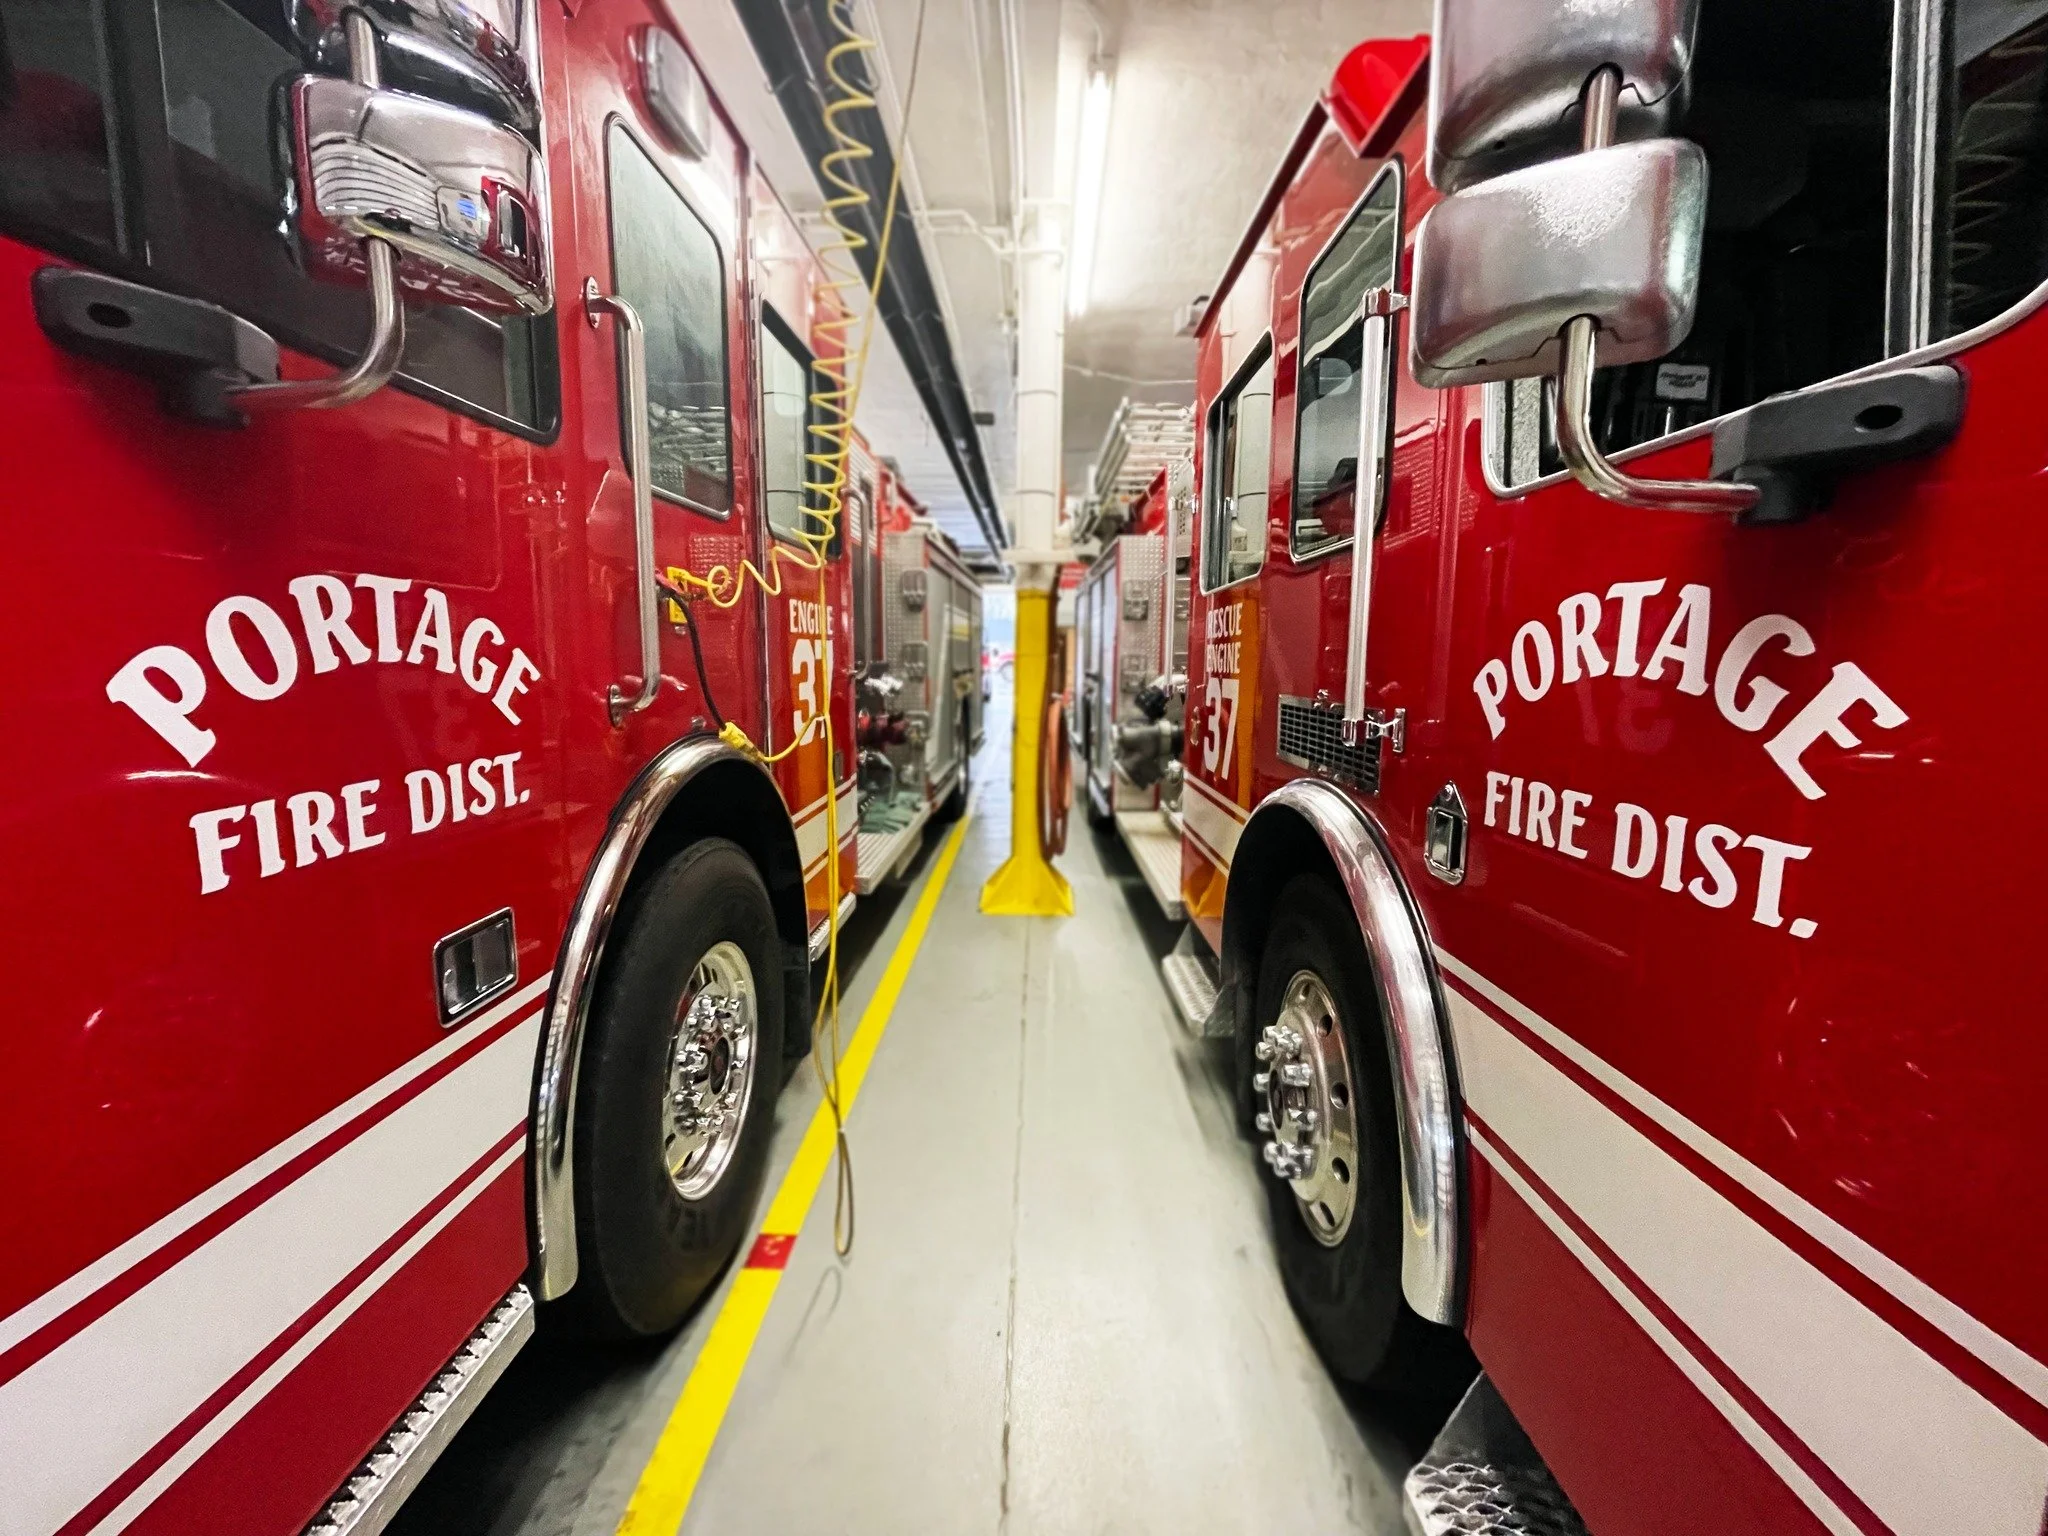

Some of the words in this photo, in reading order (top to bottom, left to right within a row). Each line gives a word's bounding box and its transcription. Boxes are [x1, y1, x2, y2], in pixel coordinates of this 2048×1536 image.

[106, 573, 541, 768] PORTAGE
[1205, 641, 1241, 674] ENGINE
[1207, 602, 1243, 638] RESCUE
[791, 639, 834, 746] 37
[1203, 676, 1240, 780] 37
[1473, 577, 1910, 800] PORTAGE
[188, 779, 386, 895] FIRE
[404, 751, 530, 834] DIST.
[1484, 770, 1593, 860] FIRE
[1611, 802, 1819, 939] DIST.
